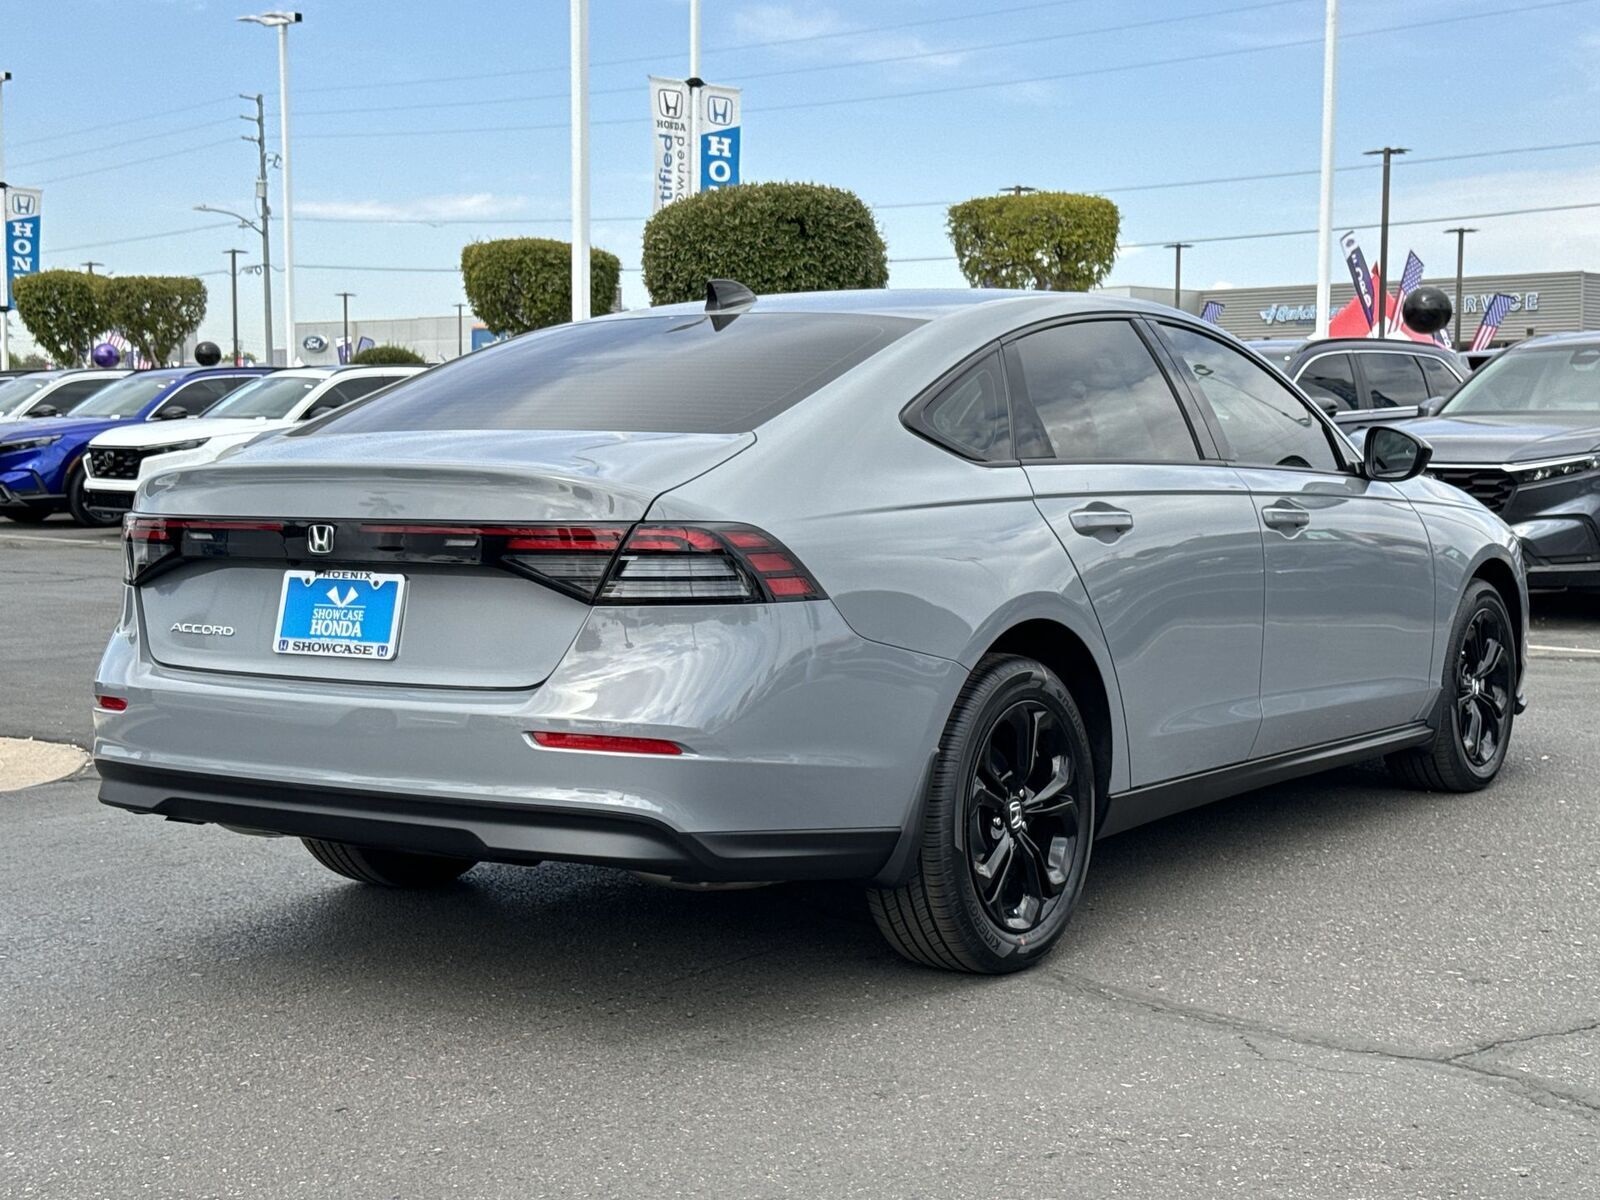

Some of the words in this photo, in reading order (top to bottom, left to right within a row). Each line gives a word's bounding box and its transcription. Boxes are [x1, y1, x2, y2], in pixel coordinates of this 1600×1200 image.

[657, 120, 686, 132] HONDA
[659, 134, 673, 206] tified
[708, 136, 731, 190] HO
[12, 222, 33, 278] HON
[314, 570, 375, 580] PHOENIX
[312, 608, 364, 620] SHOWCASE
[170, 622, 235, 637] ACCORD
[310, 620, 362, 637] HONDA
[292, 641, 374, 655] SHOWCASE
